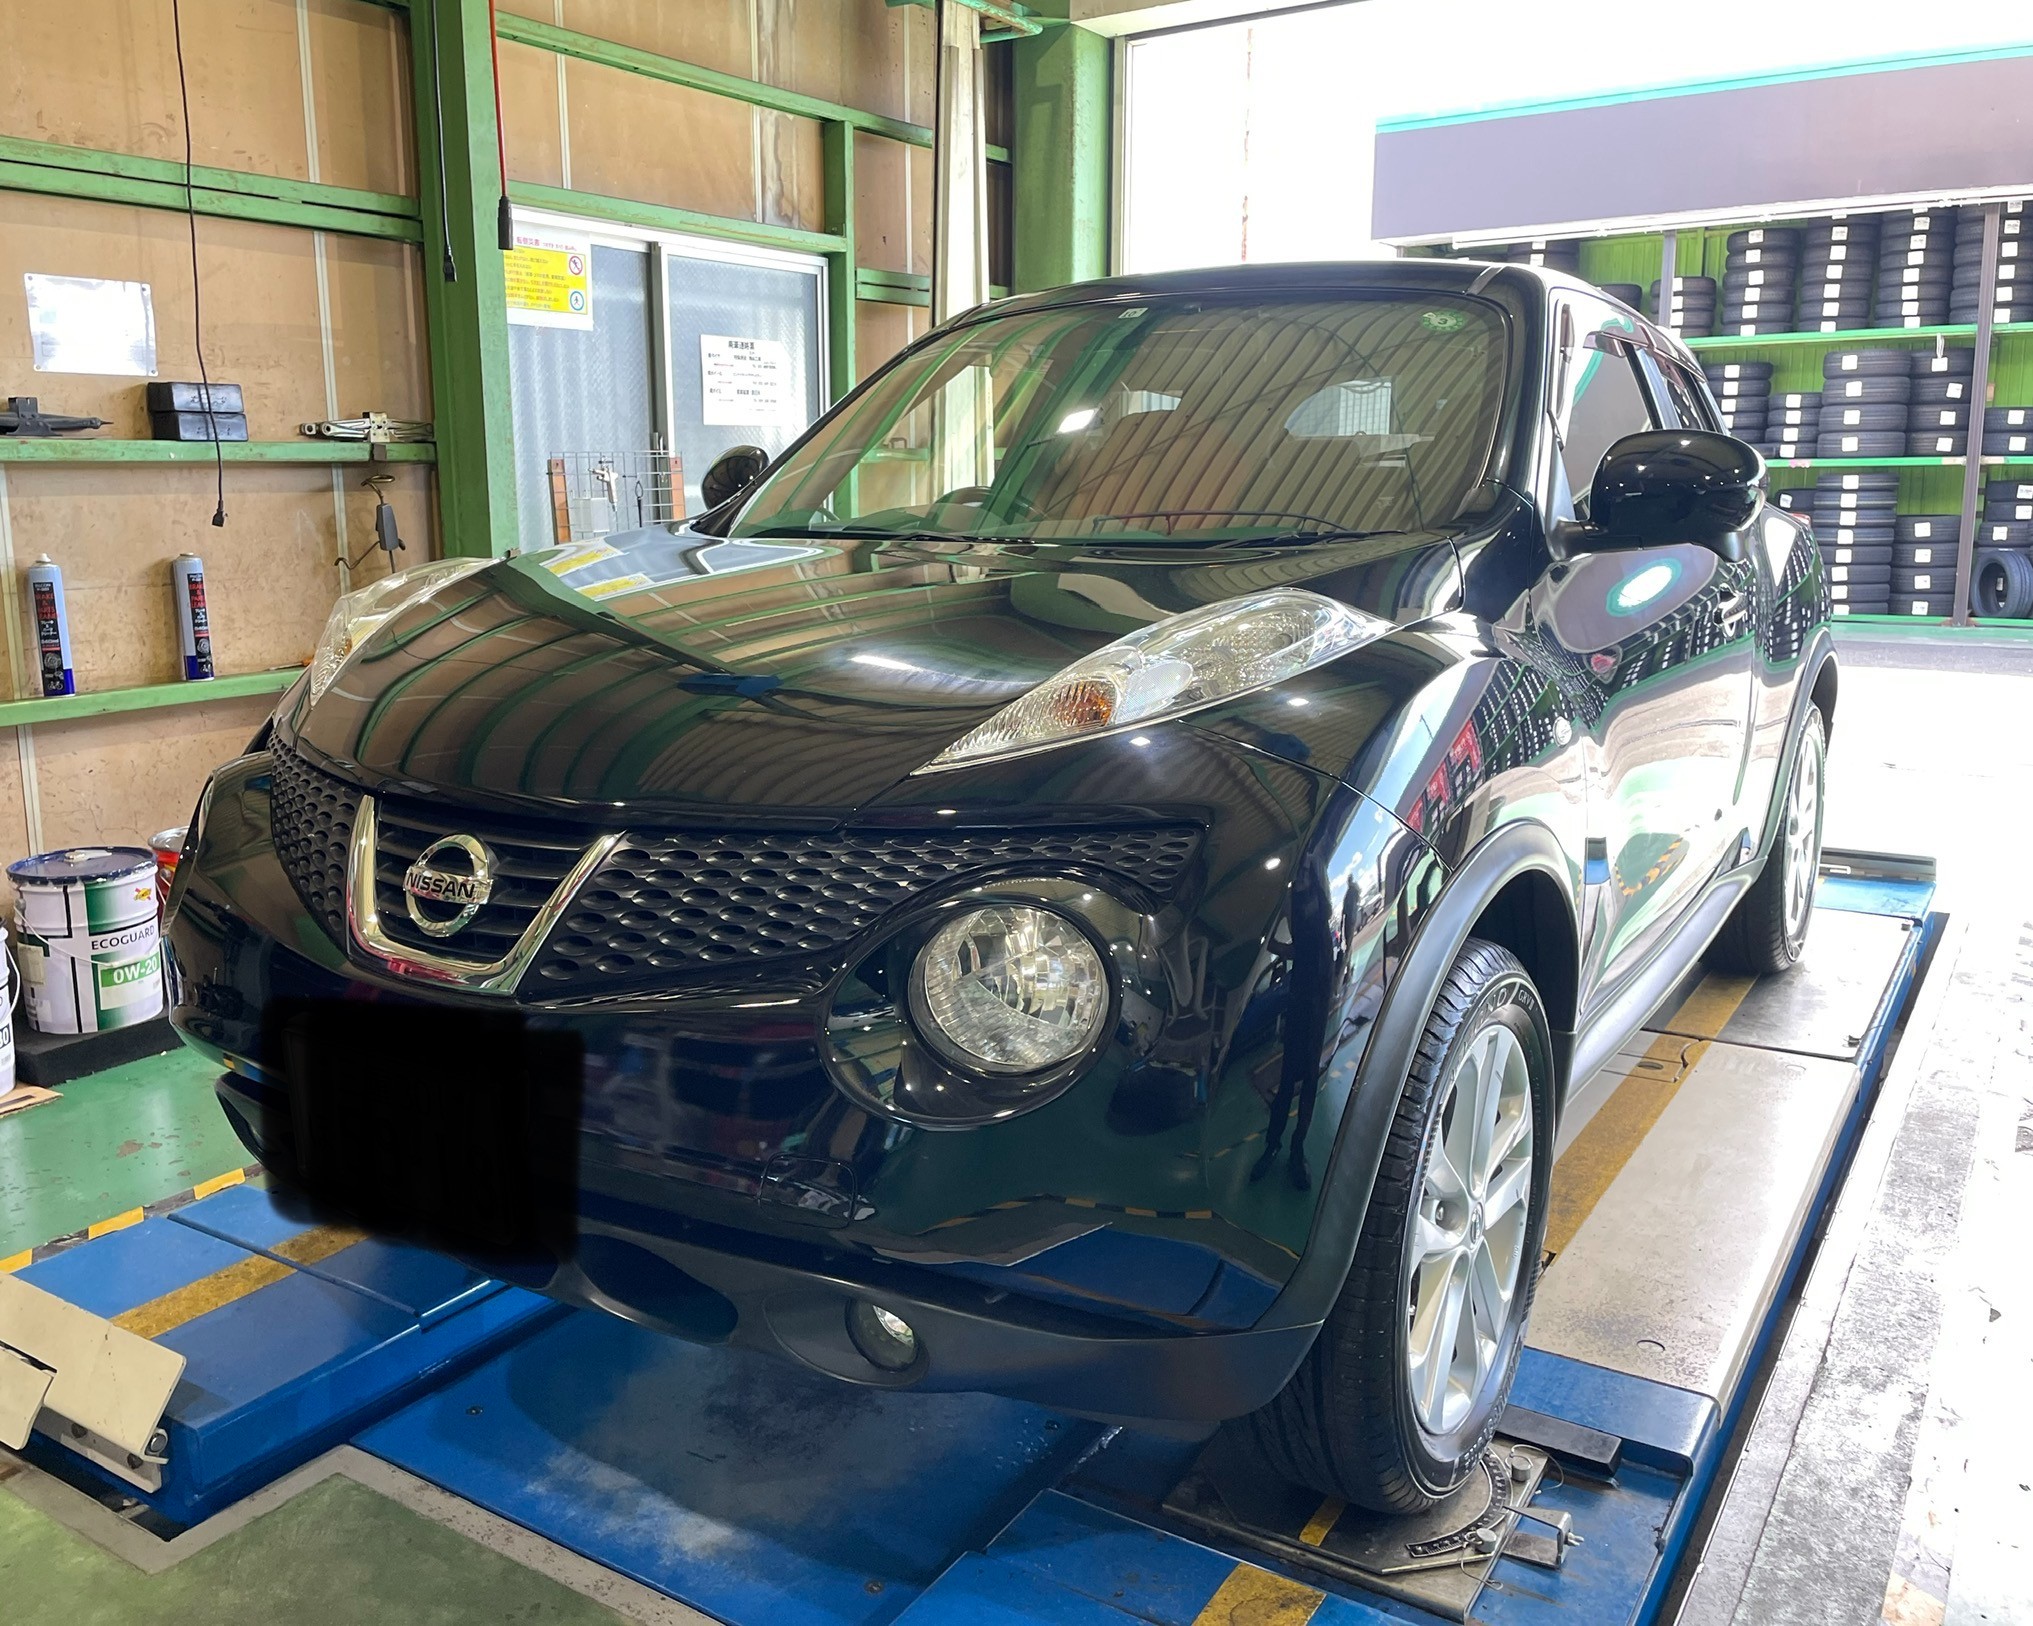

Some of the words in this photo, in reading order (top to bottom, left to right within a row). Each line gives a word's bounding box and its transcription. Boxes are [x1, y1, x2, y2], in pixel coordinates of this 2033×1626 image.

[406, 872, 475, 898] NISSAN
[91, 925, 155, 950] ECOGUARD
[113, 956, 157, 984] 0W-20
